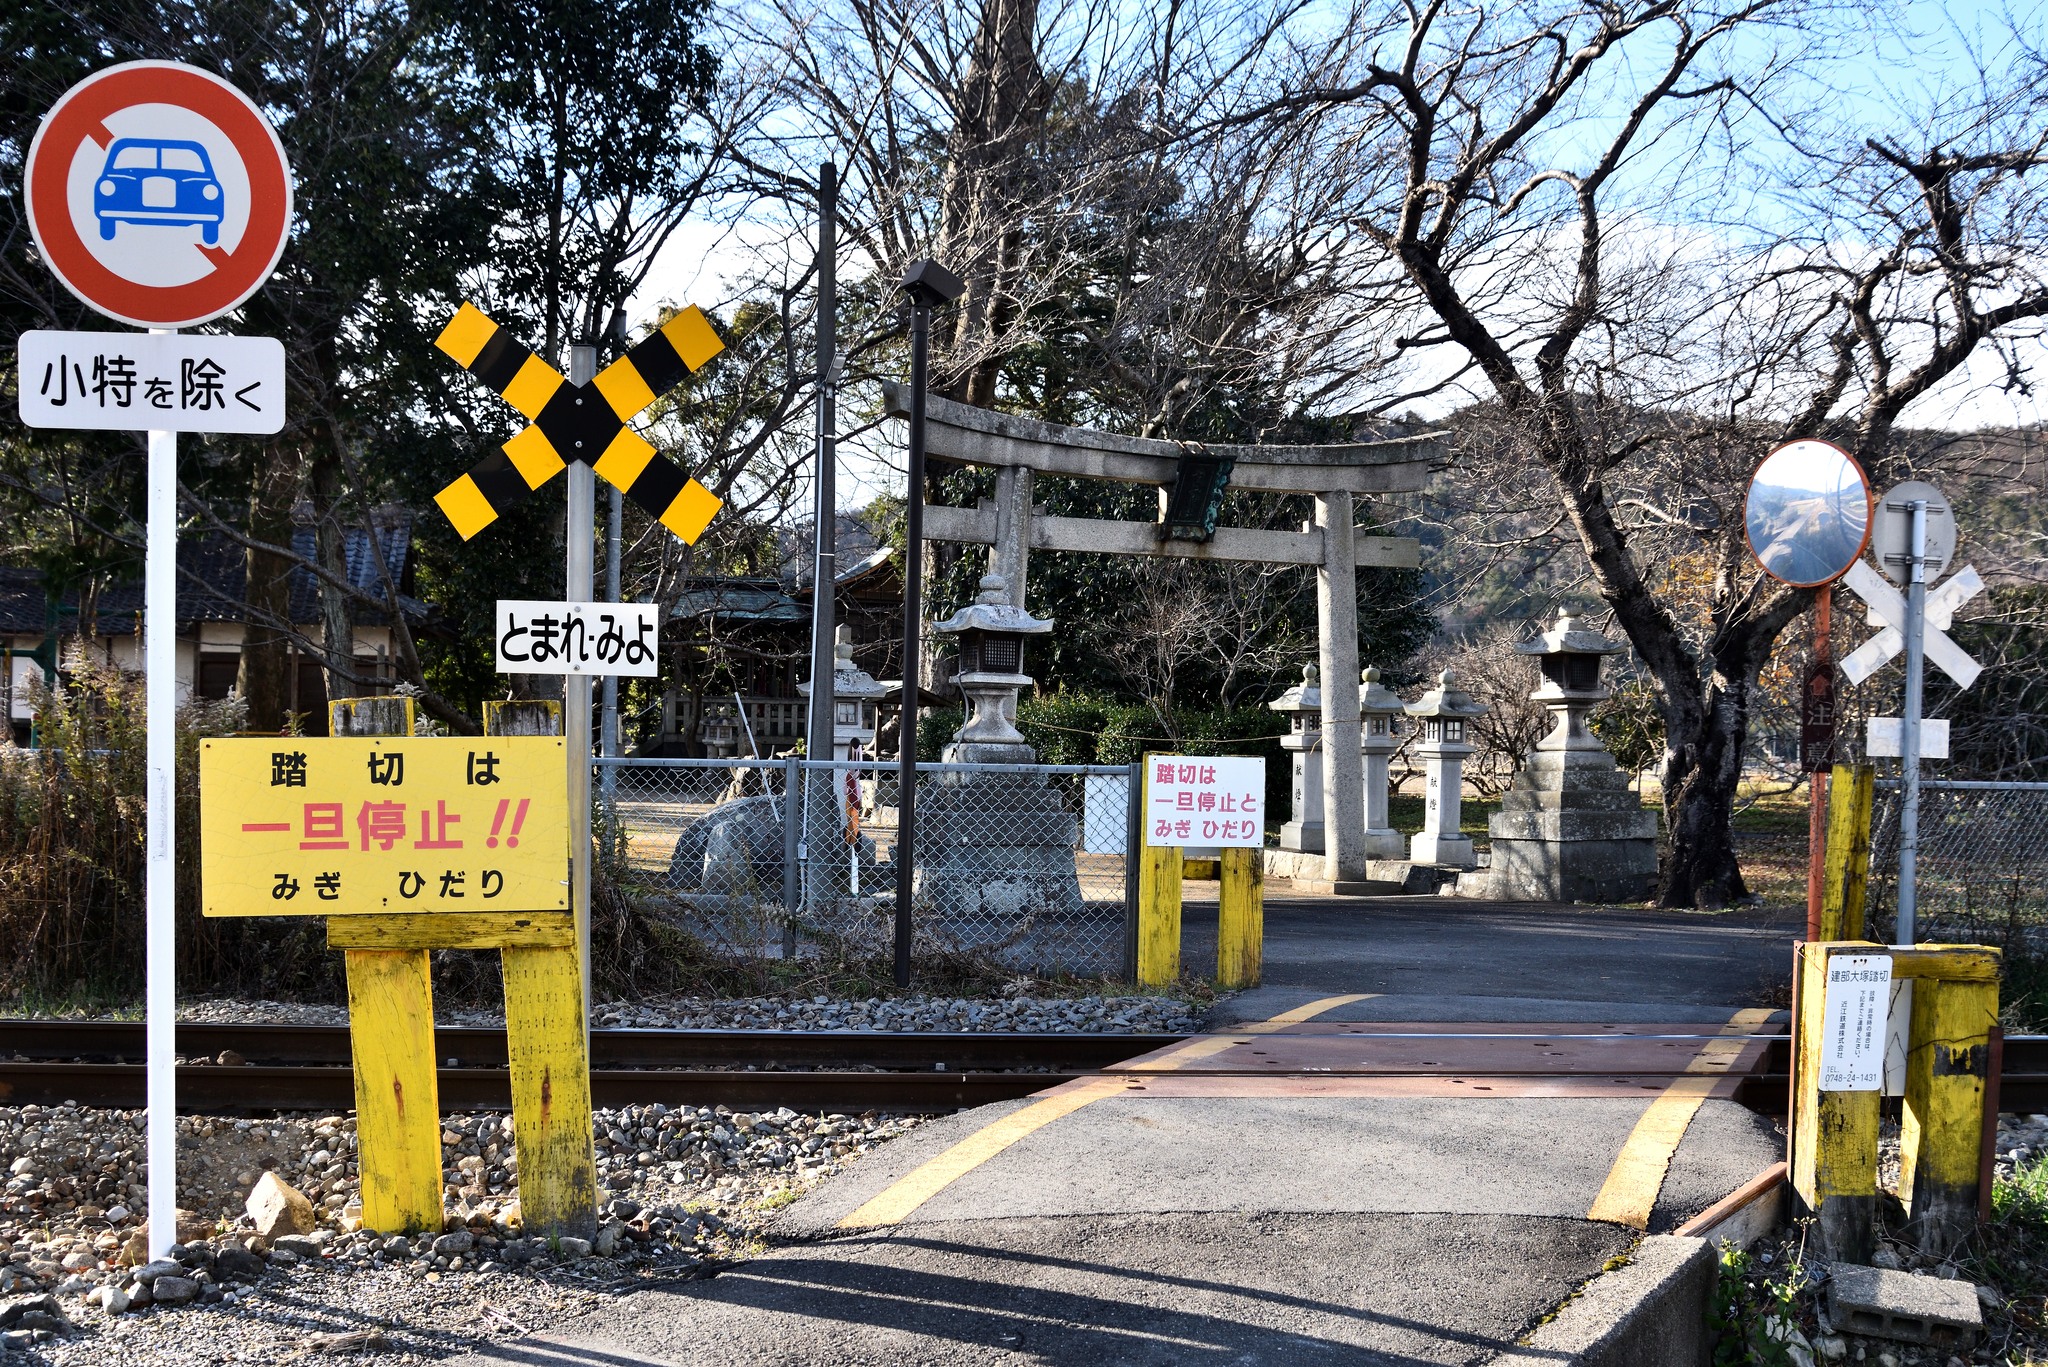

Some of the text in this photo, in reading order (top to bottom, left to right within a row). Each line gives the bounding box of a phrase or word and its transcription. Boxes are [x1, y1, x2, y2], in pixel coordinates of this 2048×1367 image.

[40, 354, 262, 412] 小特を除く
[500, 612, 655, 665] とまれ・みよ
[1807, 703, 1832, 764] 注意
[1156, 763, 1217, 784] 踏切は
[1155, 791, 1257, 812] 一旦停止と
[1831, 970, 1888, 983] 建部大塚踏切
[1837, 1000, 1848, 1058] 近江鉄道株式会社
[1825, 1073, 1877, 1082] 0748-24-1431
